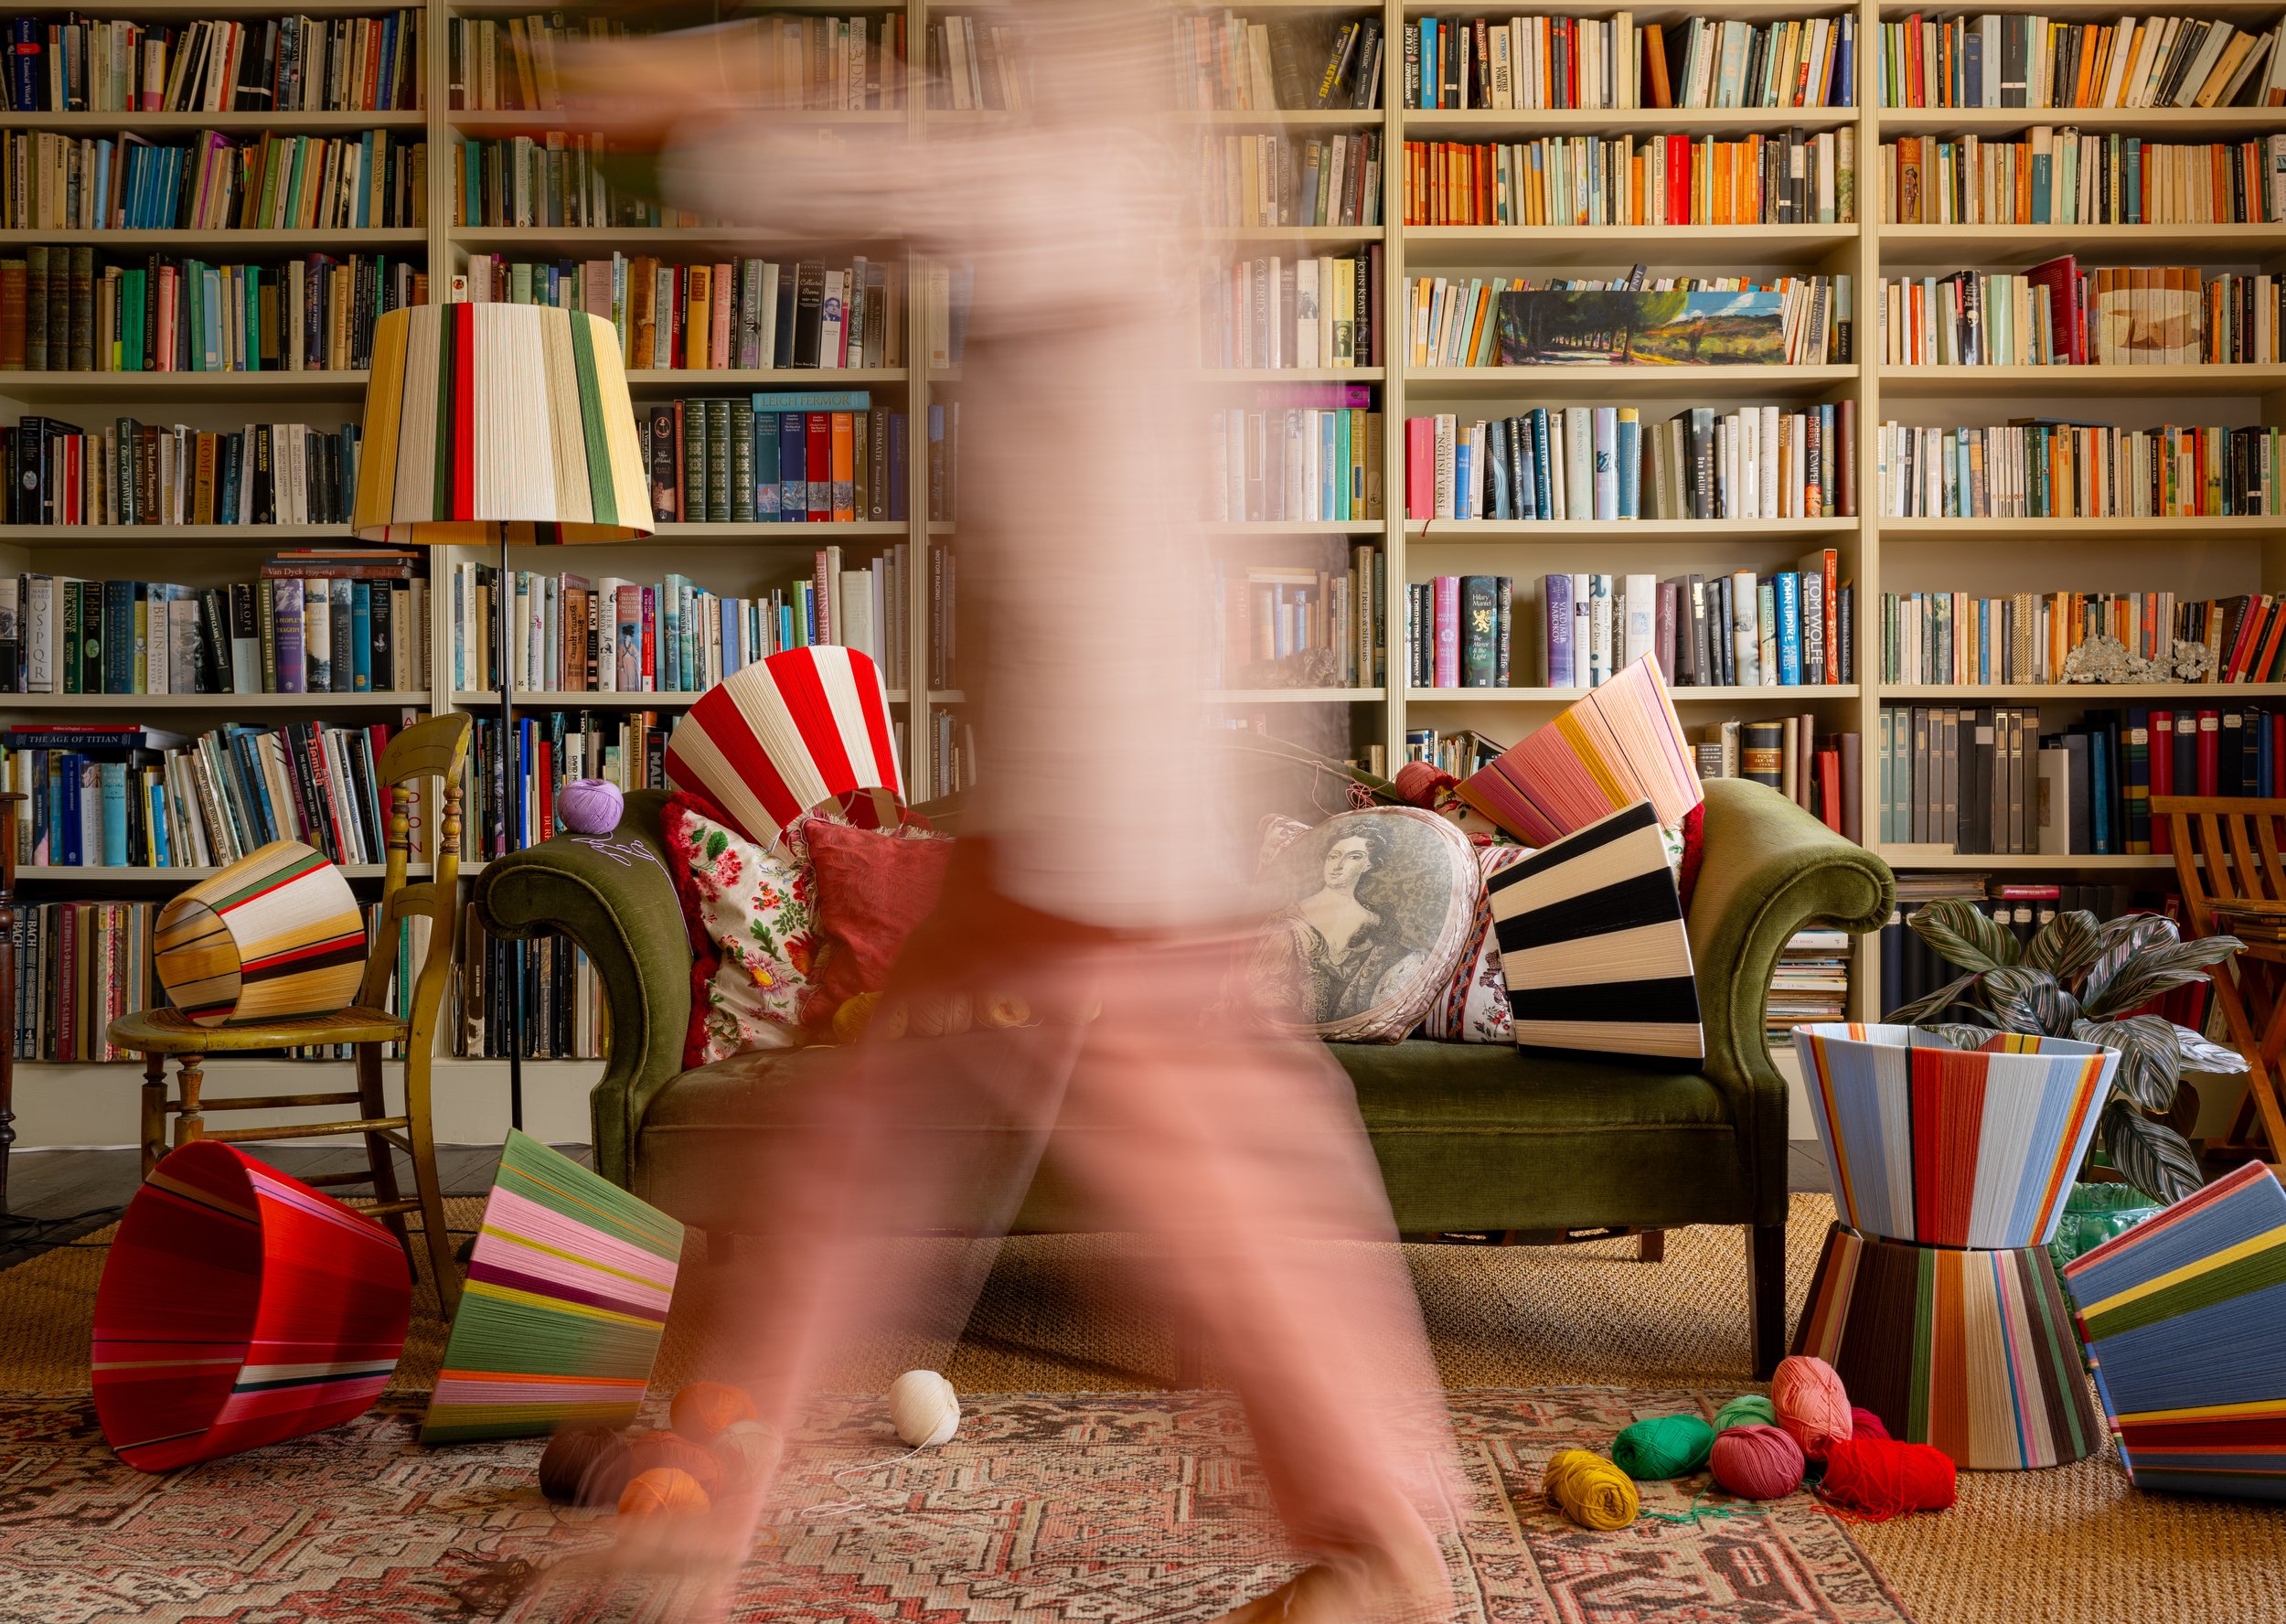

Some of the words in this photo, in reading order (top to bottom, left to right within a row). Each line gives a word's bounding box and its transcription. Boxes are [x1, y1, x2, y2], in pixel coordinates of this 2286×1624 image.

[23, 21, 31, 43] Oxford
[177, 34, 187, 55] FREUD
[1366, 27, 1376, 43] Jack
[1405, 27, 1413, 54] BOYD
[1477, 24, 1485, 60] Bukowski
[1362, 42, 1372, 69] Kerouac
[24, 85, 32, 104] World
[850, 64, 862, 100] DNA
[1319, 64, 1337, 98] KEYNES
[518, 143, 527, 190] Irreplaceable
[747, 262, 756, 291] PHILIP
[1356, 262, 1366, 285] JOHN
[1256, 259, 1266, 325] COLERIDGE
[1356, 289, 1366, 315] KEATS
[746, 294, 755, 332] LARKIN
[762, 397, 796, 407] LEIGH
[800, 395, 849, 406] FERMOR
[874, 411, 882, 461] AFTERMATH
[1512, 422, 1520, 440] PAUL
[1538, 413, 1546, 433] SAUL
[1779, 419, 1787, 446] Palazzo
[121, 445, 129, 465] Oliver
[147, 443, 155, 454] The
[200, 439, 210, 476] ROME
[245, 430, 254, 466] Meadowland
[1539, 435, 1547, 466] BELLOW
[147, 456, 155, 474] Later
[1809, 450, 1818, 484] POMPEII
[121, 465, 130, 514] CROMWELL
[136, 487, 143, 497] OF
[147, 474, 155, 511] Plantagenets
[283, 567, 303, 578] Dyck
[817, 565, 829, 616] BRITAIN'S
[1784, 576, 1793, 604] JOHN
[1811, 578, 1821, 604] TOM
[65, 588, 73, 633] FRANCE
[206, 595, 216, 622] KENNETH
[242, 589, 252, 632] EUROPE
[2235, 600, 2248, 631] STRANGERS
[153, 606, 165, 649] BERLIN
[210, 621, 219, 639] CLARK
[1552, 602, 1560, 643] NABOKOV
[1784, 607, 1793, 641] UPDIKE
[1811, 609, 1822, 664] WOLFE
[632, 718, 642, 766] Leonardo
[198, 766, 207, 783] HOW
[307, 739, 325, 786] Flemish
[202, 784, 210, 792] TO
[205, 794, 214, 807] DRAW
[289, 766, 302, 802] STRAWBERRY
[296, 804, 304, 817] HILL
[208, 808, 219, 825] WHAT
[213, 827, 221, 838] YOU
[217, 839, 225, 850] SEE
[13, 921, 23, 947] BACH
[27, 921, 37, 946] BACH
